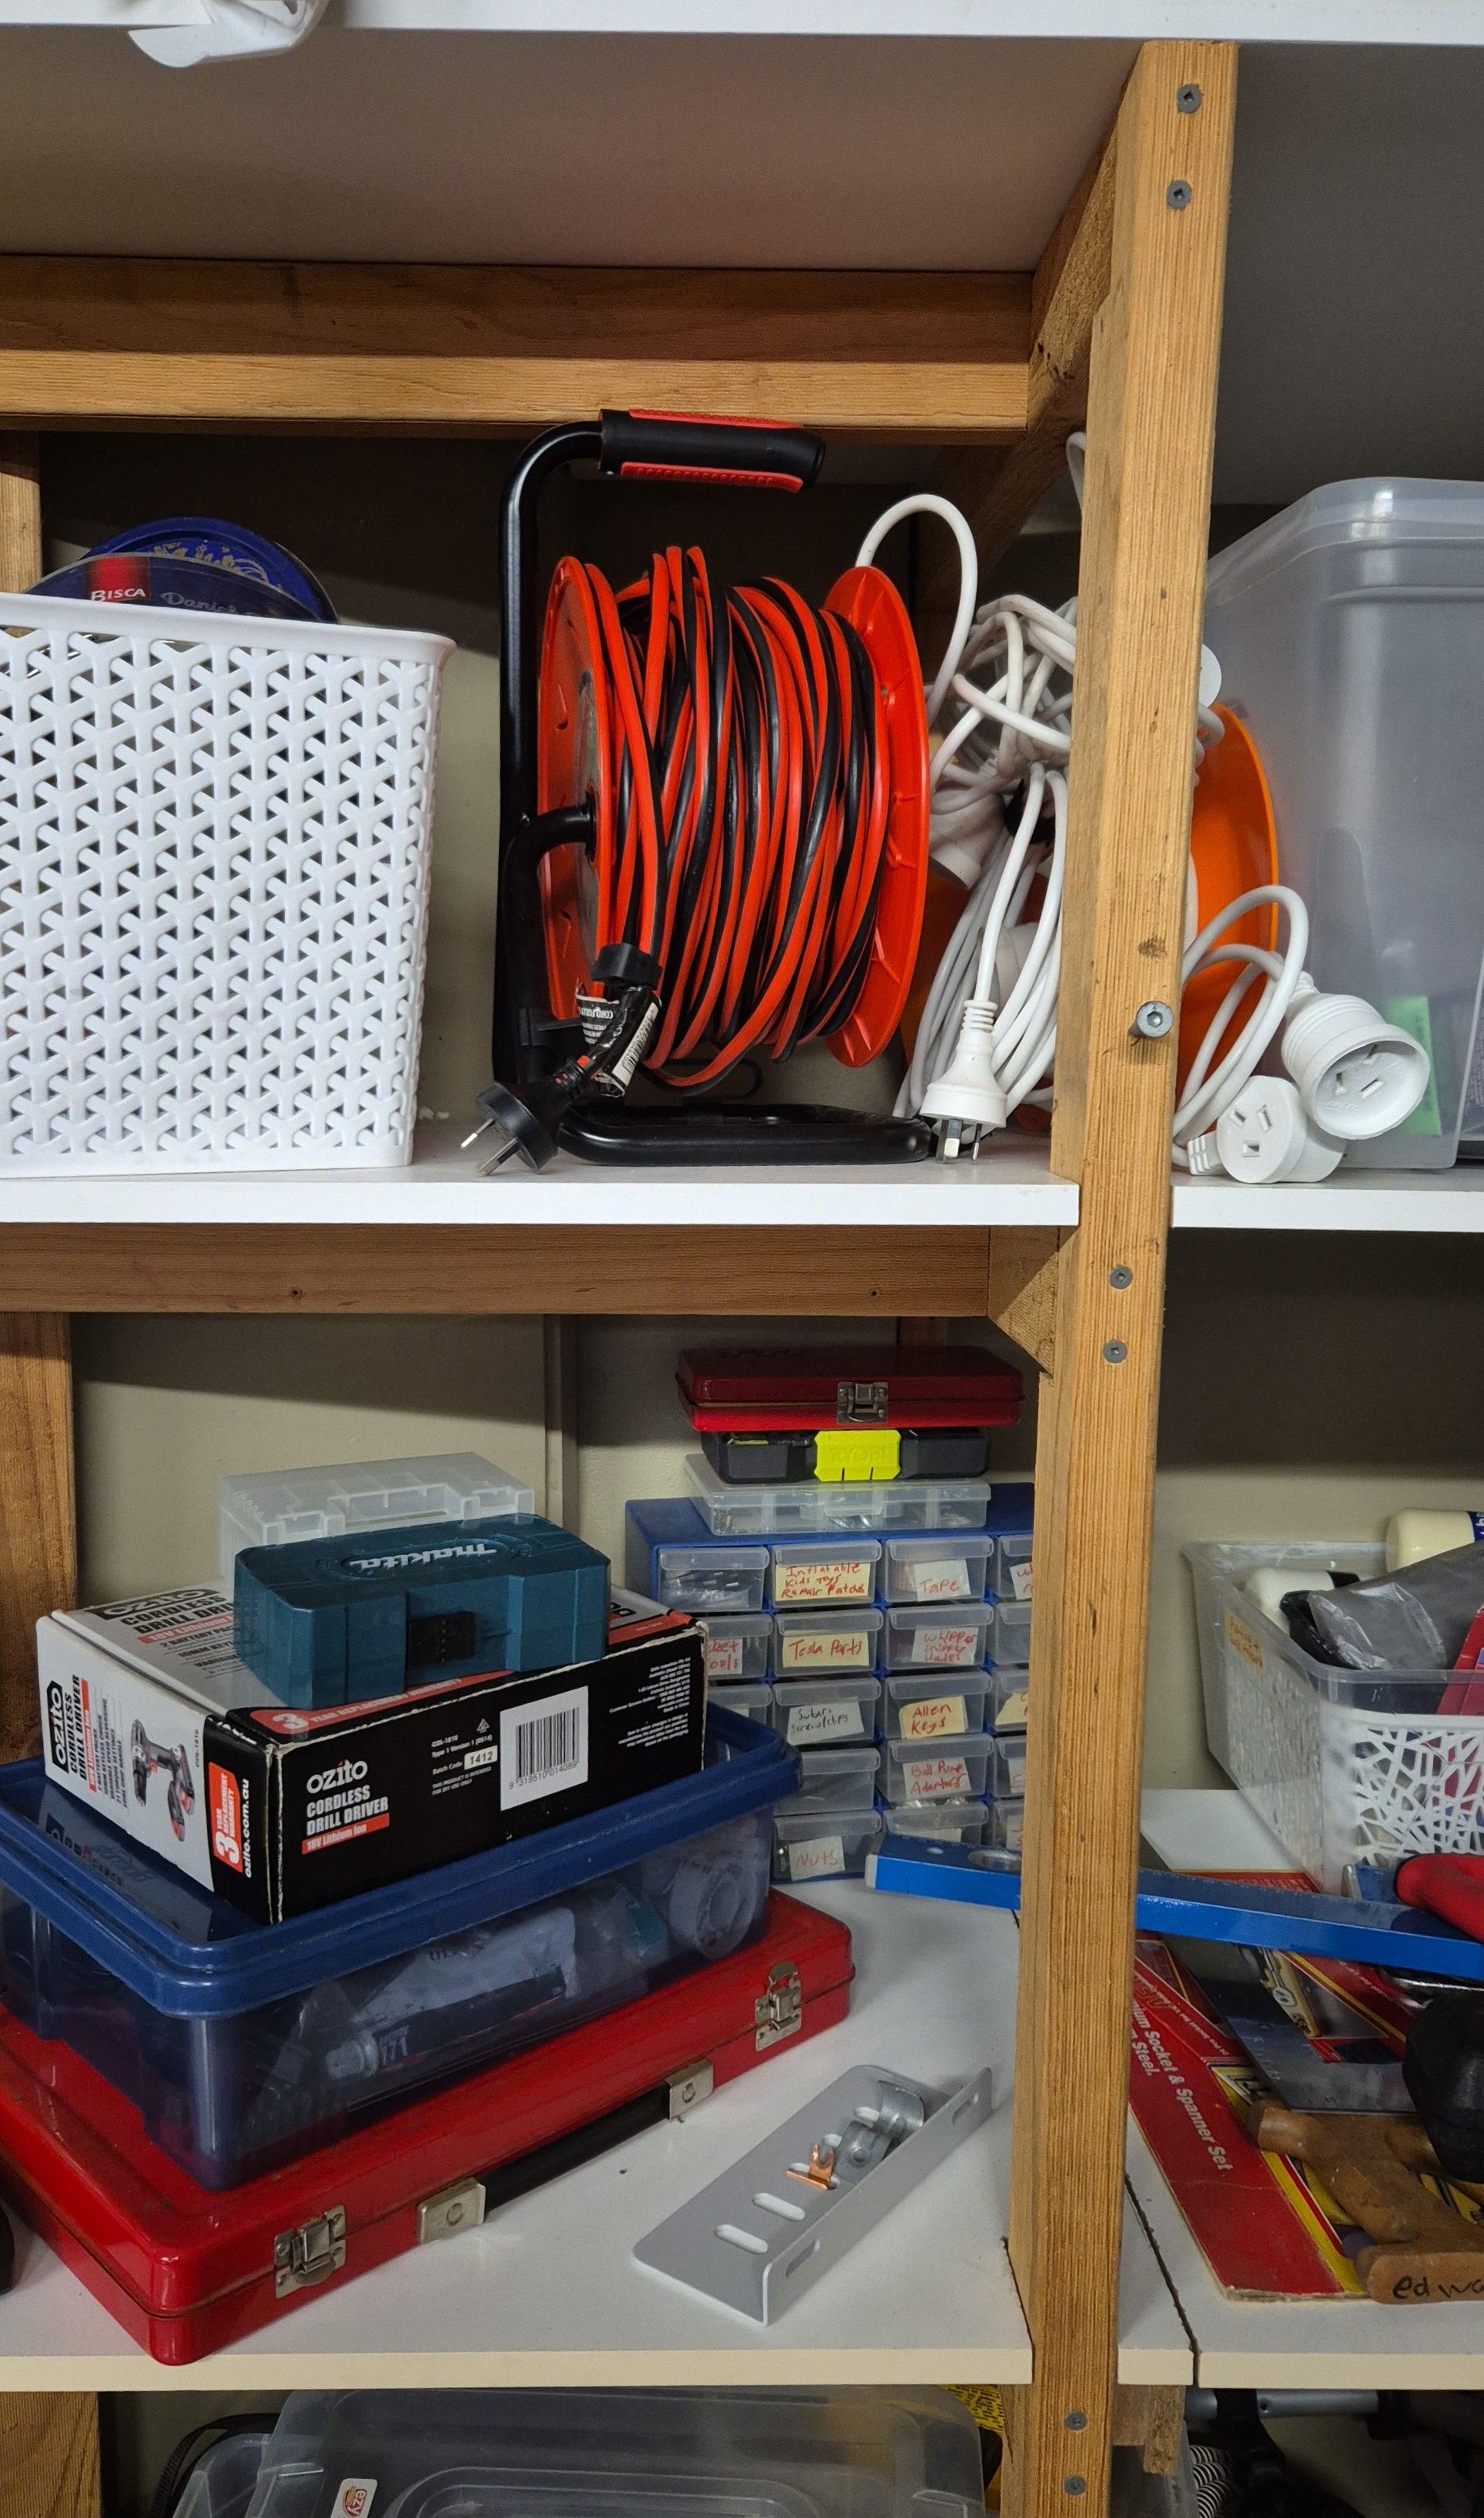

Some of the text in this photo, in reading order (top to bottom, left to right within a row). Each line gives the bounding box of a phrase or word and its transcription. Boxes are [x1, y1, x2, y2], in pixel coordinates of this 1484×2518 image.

[91, 588, 146, 602] BISCA
[103, 1590, 201, 1615] ozito
[120, 1595, 227, 1626] CORDLESS
[131, 1601, 234, 1635] DRILL DRI
[788, 1639, 823, 1660] Tesla
[51, 1687, 67, 1766] ozito
[72, 1674, 88, 1781] DRILL DRIVER
[272, 1712, 309, 1729] 3
[911, 1717, 947, 1735] Keys
[912, 1703, 952, 1719] Allen
[65, 1693, 78, 1774] CORDLESS
[470, 1750, 494, 1766] 1412
[307, 1759, 368, 1794] ozito
[307, 1784, 370, 1819] CORDLESS
[307, 1796, 389, 1836] DRILL DRIVER
[241, 1778, 252, 1879] ozito.com.au
[215, 1831, 241, 1865] 3
[1147, 2029, 1179, 2074] Socket
[1168, 2075, 1185, 2086] &
[1176, 2088, 1217, 2144] Spanner
[1207, 2144, 1233, 2171] Set
